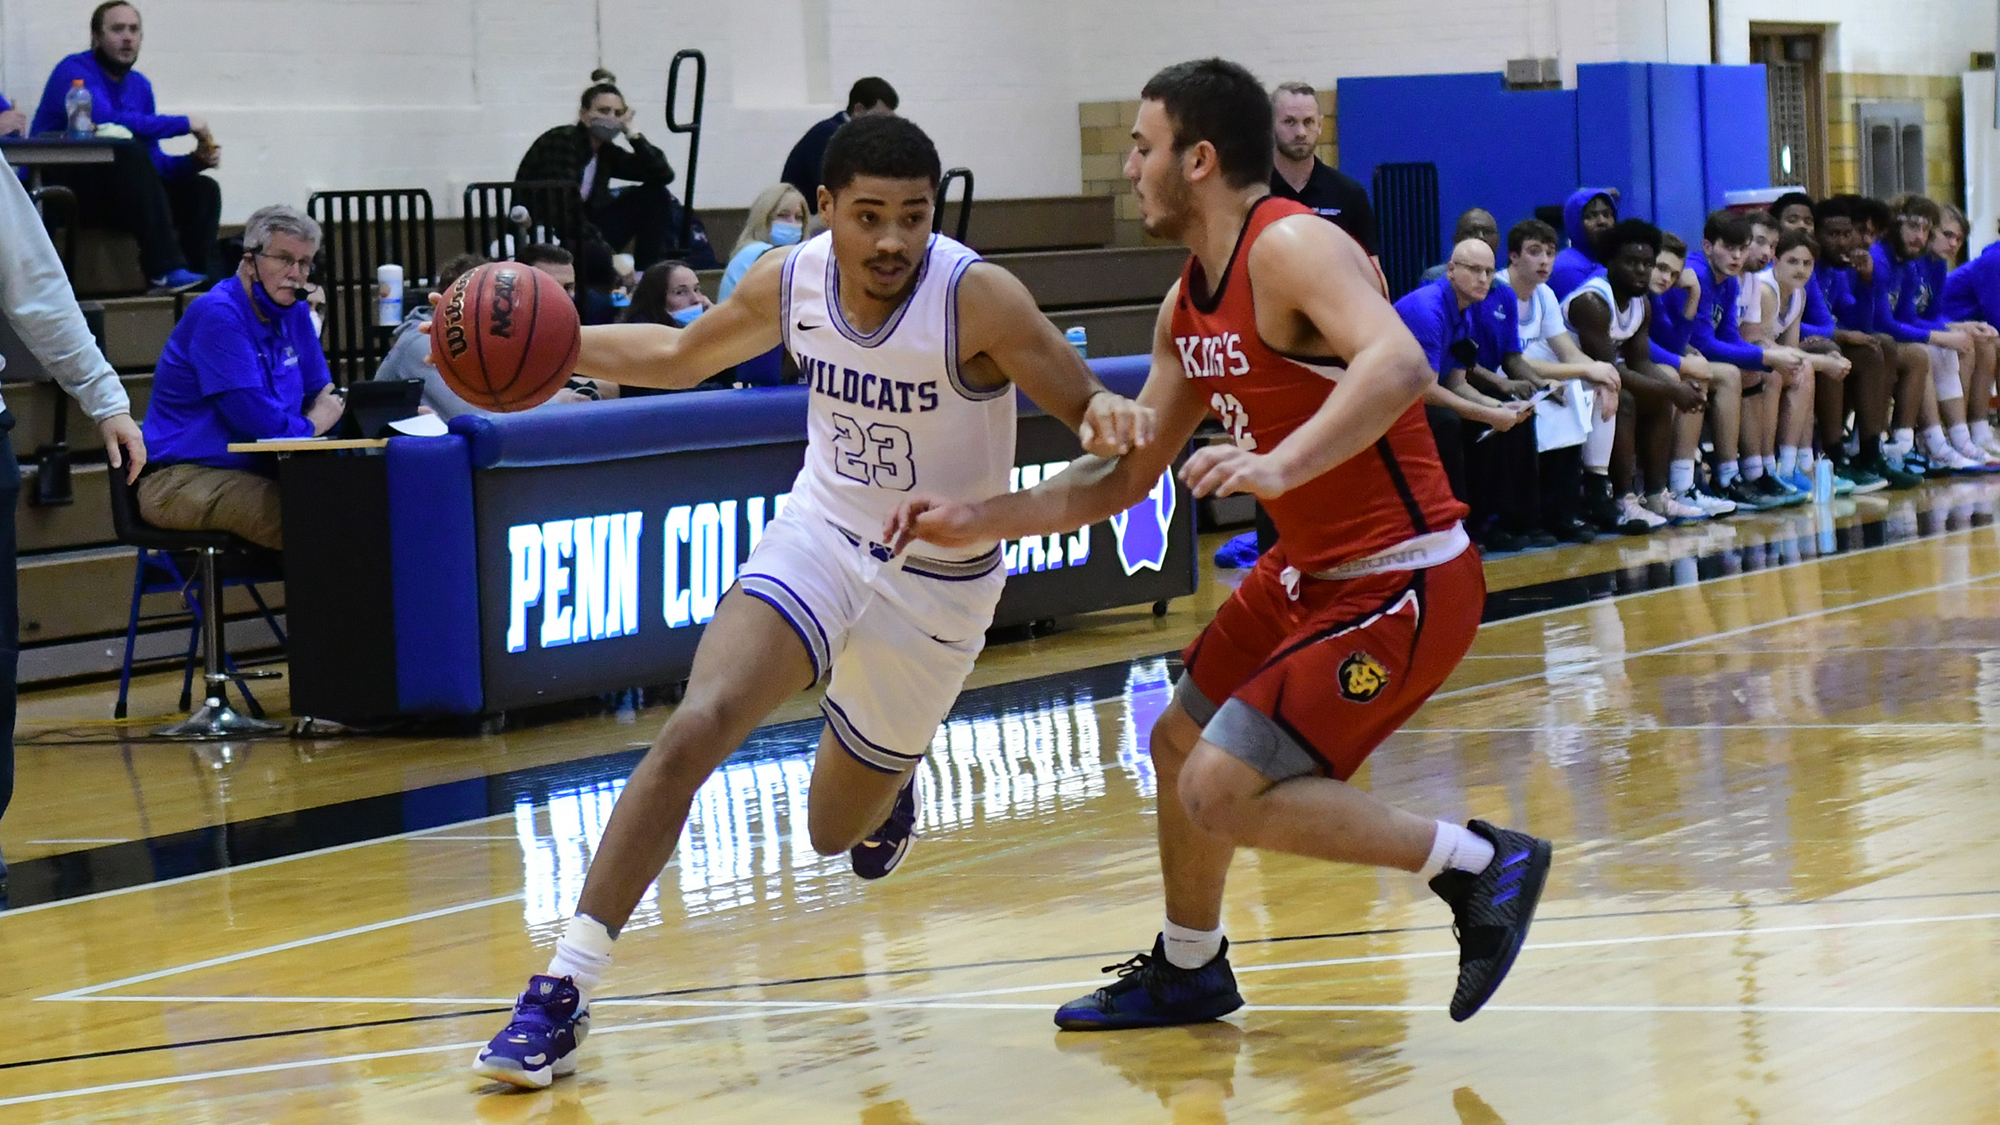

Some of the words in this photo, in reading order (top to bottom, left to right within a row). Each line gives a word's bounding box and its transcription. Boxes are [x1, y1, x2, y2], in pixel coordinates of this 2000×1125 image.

[490, 271, 518, 339] NCAA
[796, 352, 939, 413] WILDCATS
[831, 412, 917, 492] 23
[507, 511, 643, 653] PENN
